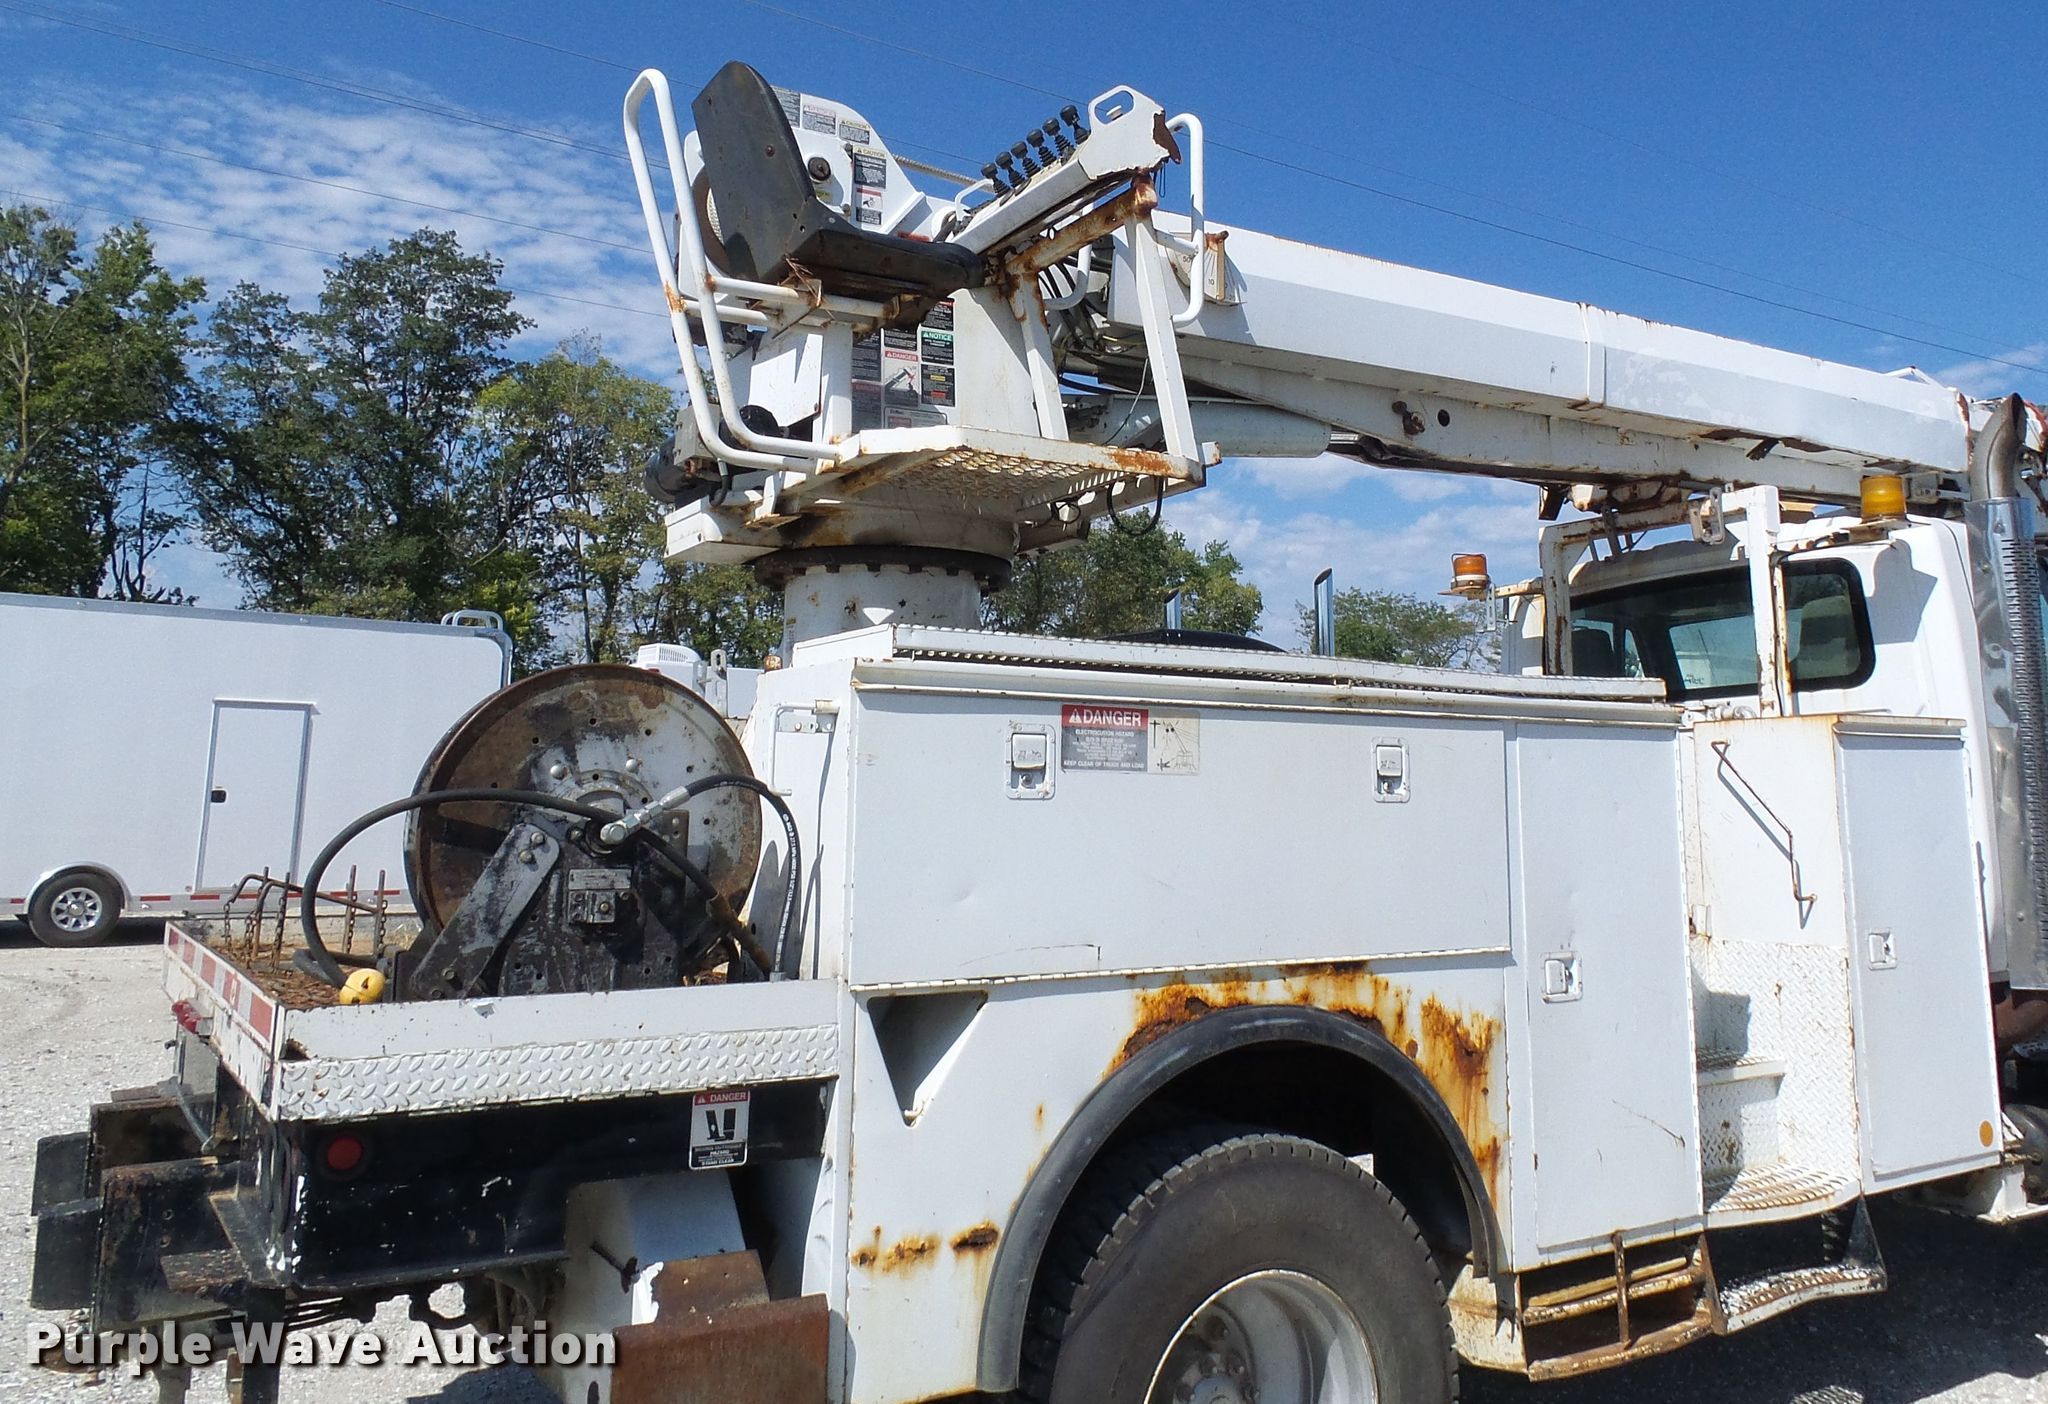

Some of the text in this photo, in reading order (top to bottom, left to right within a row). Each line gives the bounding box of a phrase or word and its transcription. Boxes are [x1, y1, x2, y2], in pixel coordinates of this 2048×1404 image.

[863, 149, 886, 158] CAUTION
[928, 333, 952, 341] NOTICE
[892, 352, 917, 361] DANGER
[1083, 709, 1141, 726] DANGER
[1075, 729, 1114, 737] ELECTROCUTION
[710, 1092, 746, 1102] DANGER
